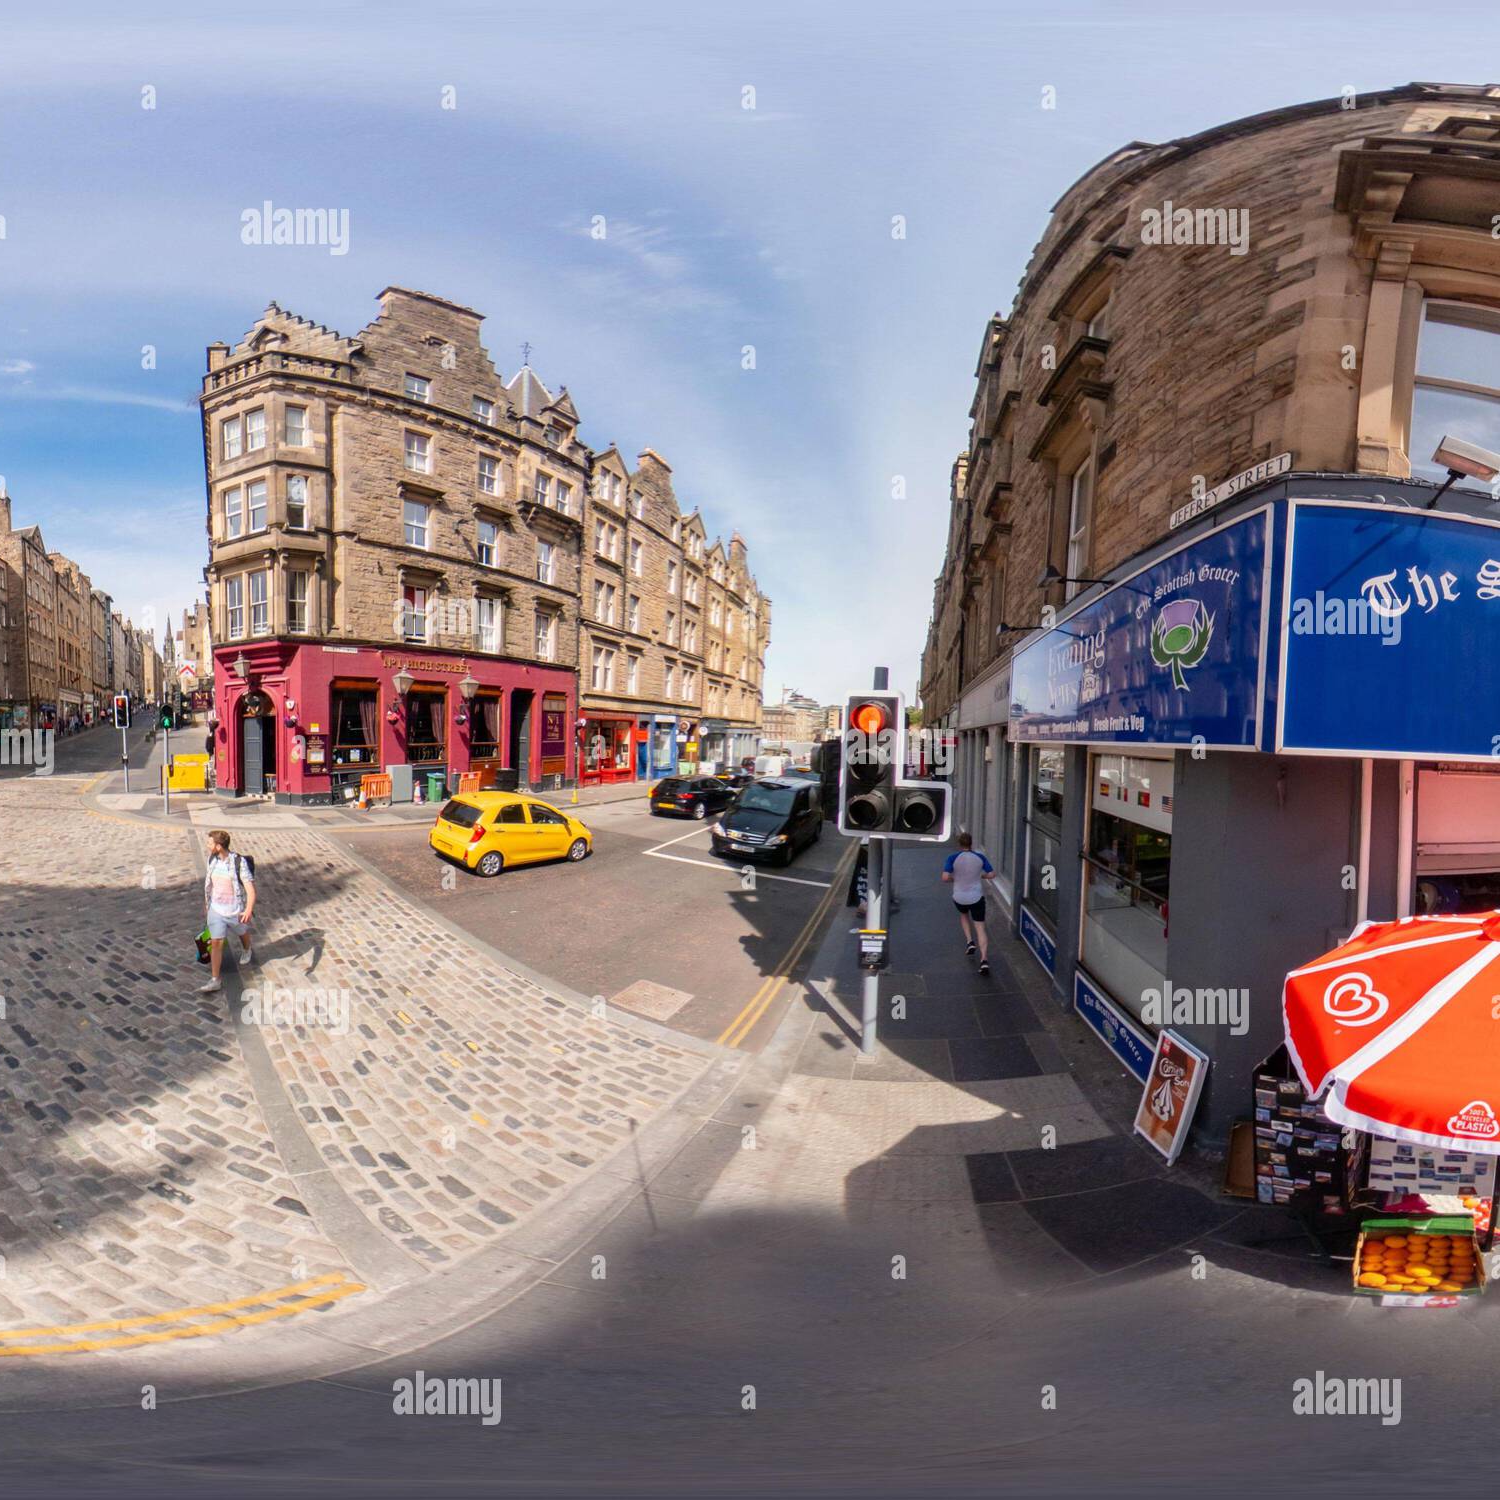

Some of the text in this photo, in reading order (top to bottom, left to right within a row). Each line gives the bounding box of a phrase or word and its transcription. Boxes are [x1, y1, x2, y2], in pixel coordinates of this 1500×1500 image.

[1171, 455, 1288, 528] JEFFREY STREET
[1153, 567, 1195, 603] Scottish
[1198, 563, 1240, 586] Grocer
[1361, 564, 1461, 618] The
[407, 660, 434, 672] HIGH
[435, 663, 473, 675] STREET
[1048, 628, 1106, 677] Evening
[1094, 717, 1109, 731] Fresh
[1110, 715, 1124, 731] Fruit
[1130, 713, 1145, 732] Veg
[1119, 1026, 1144, 1062] Grocer
[1456, 1120, 1493, 1133] PLASTIC
